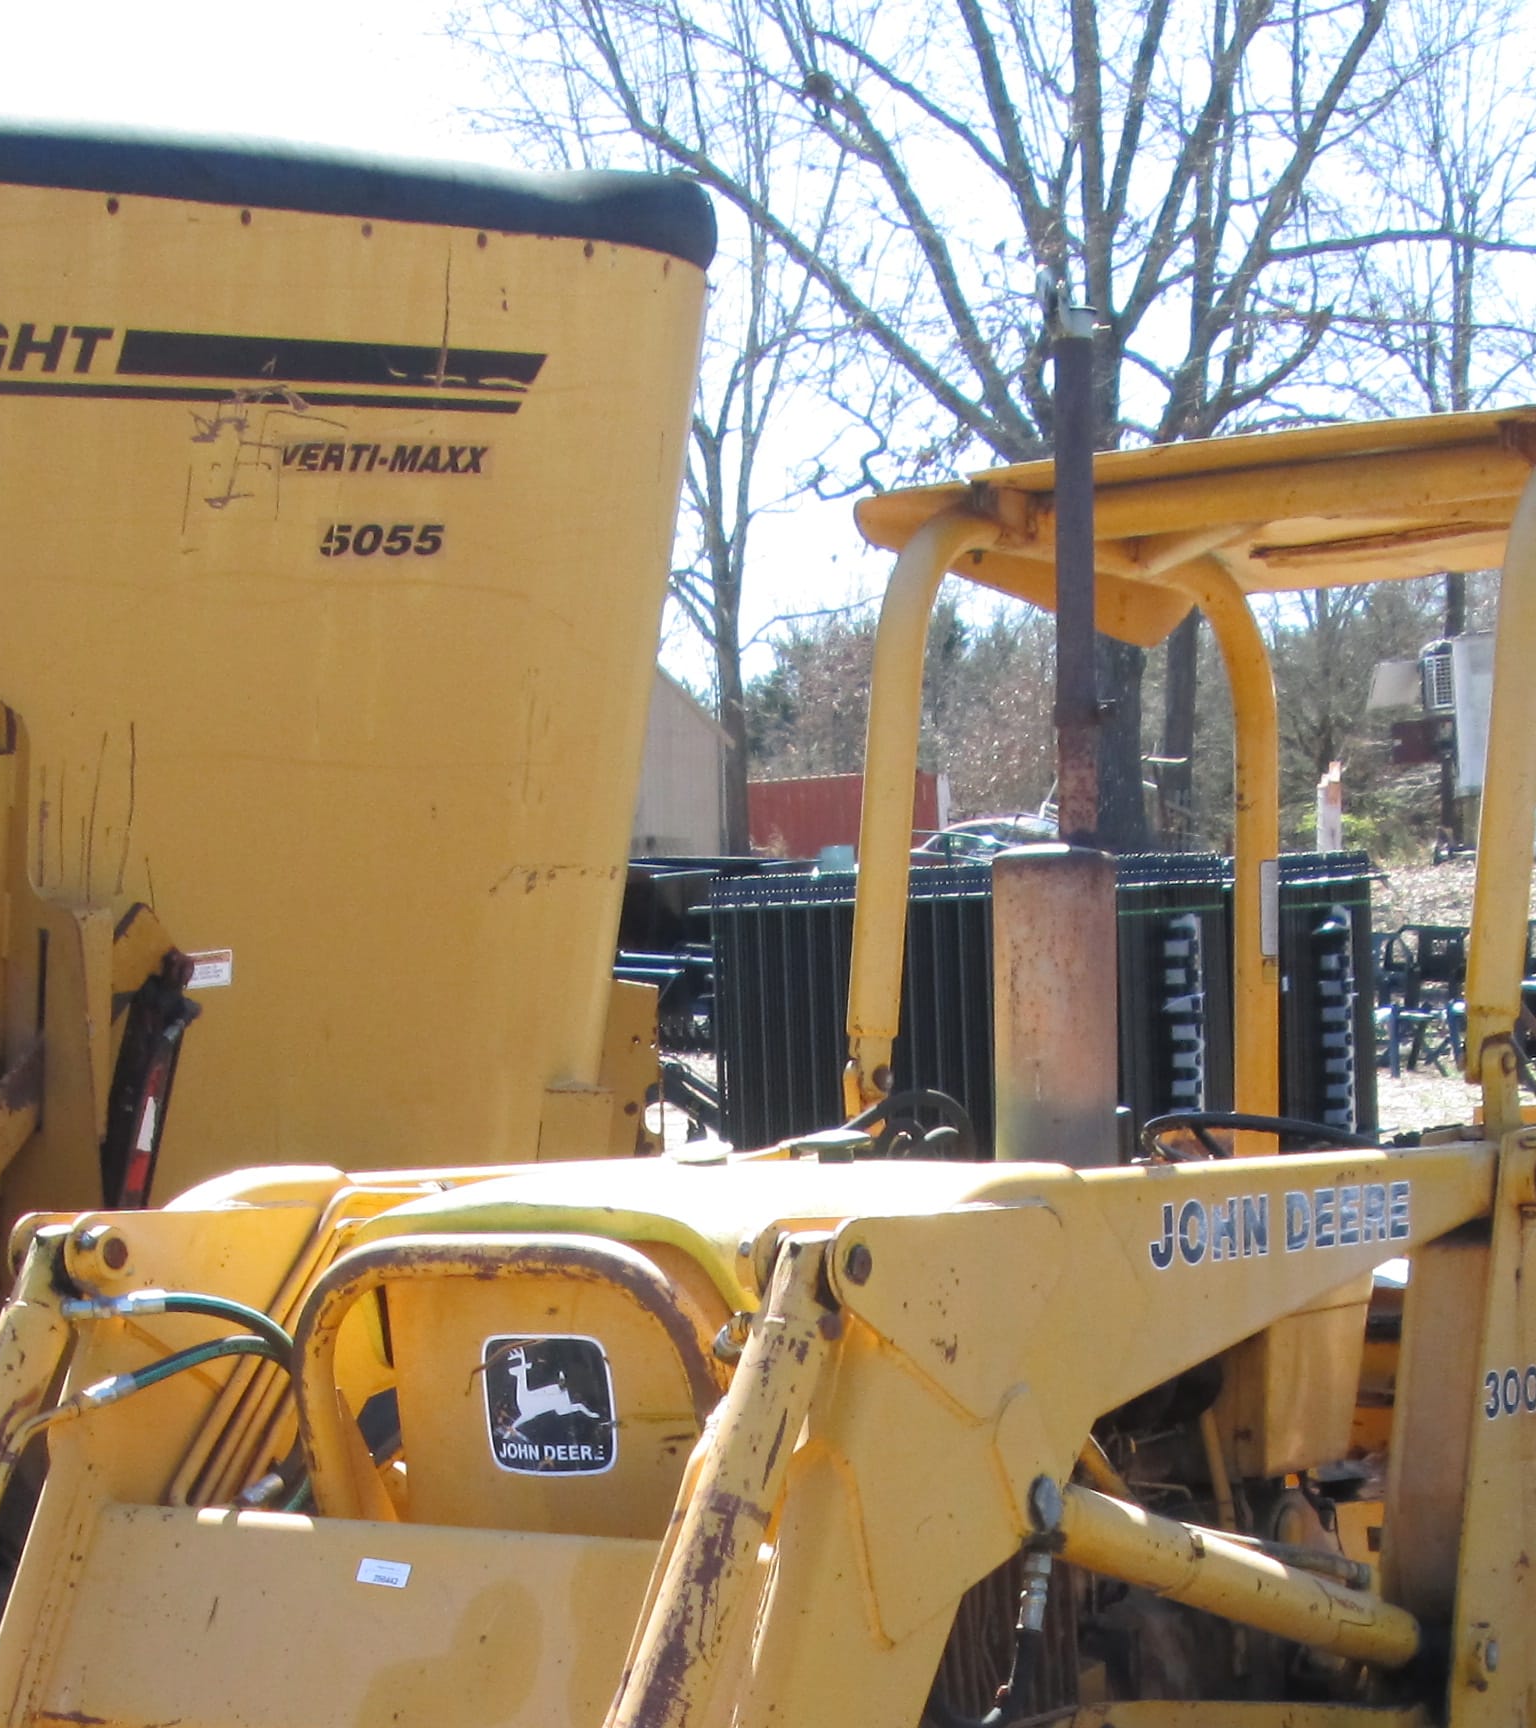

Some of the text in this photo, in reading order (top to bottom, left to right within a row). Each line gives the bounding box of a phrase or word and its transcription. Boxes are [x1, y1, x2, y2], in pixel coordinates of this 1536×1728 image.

[281, 442, 489, 474] VERTI-MAXX
[319, 523, 445, 557] 5055
[1149, 1180, 1412, 1270] JOHN DEERE
[498, 1443, 540, 1461] JOHN
